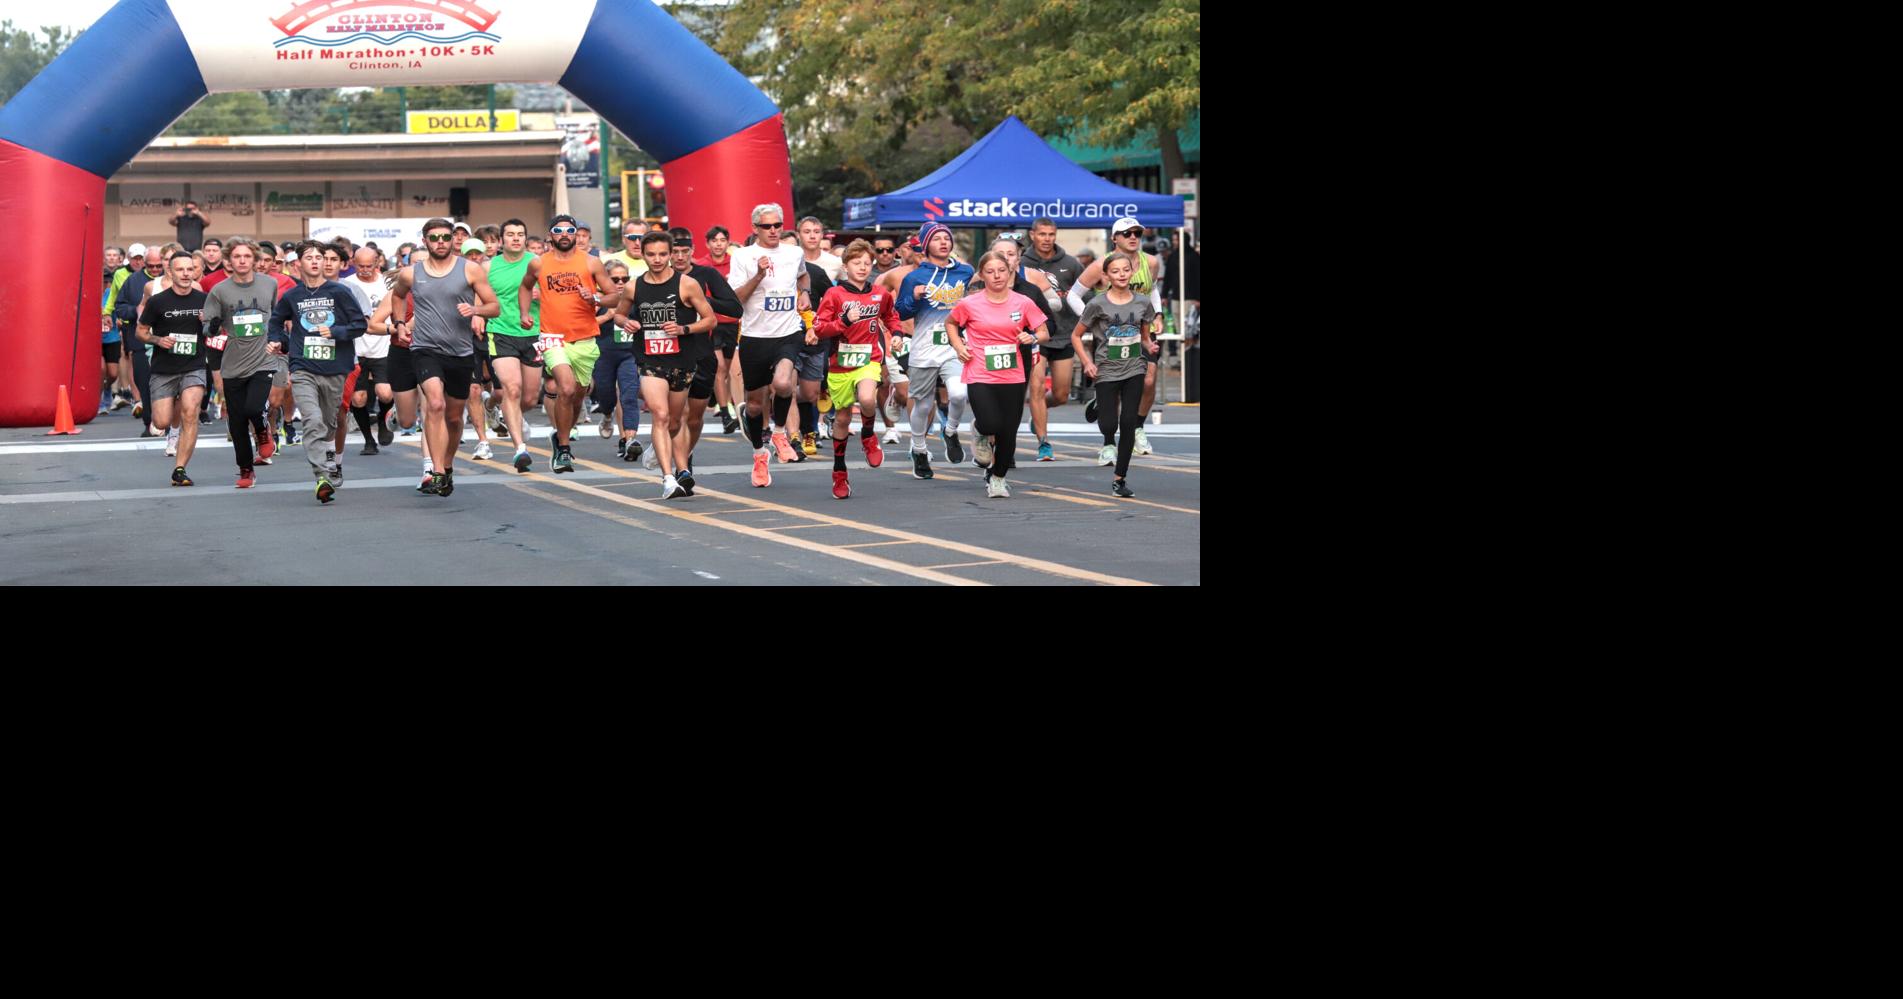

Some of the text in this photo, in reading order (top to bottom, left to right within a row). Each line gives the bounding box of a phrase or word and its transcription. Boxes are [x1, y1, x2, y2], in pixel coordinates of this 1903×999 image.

[338, 13, 433, 25] CLINTON
[326, 23, 445, 33] HALF MARATHON
[276, 45, 494, 60] Half Marathon 10K 5K
[349, 60, 422, 70] Clinton, IA
[768, 297, 792, 311] 370
[640, 308, 677, 324] RWE
[244, 324, 253, 337] 2
[869, 320, 878, 334] 6
[173, 342, 193, 355] 143
[307, 346, 331, 360] 133
[650, 339, 674, 353] 572
[1120, 346, 1130, 358] 8
[842, 353, 867, 367] 142
[993, 354, 1012, 369] 88
